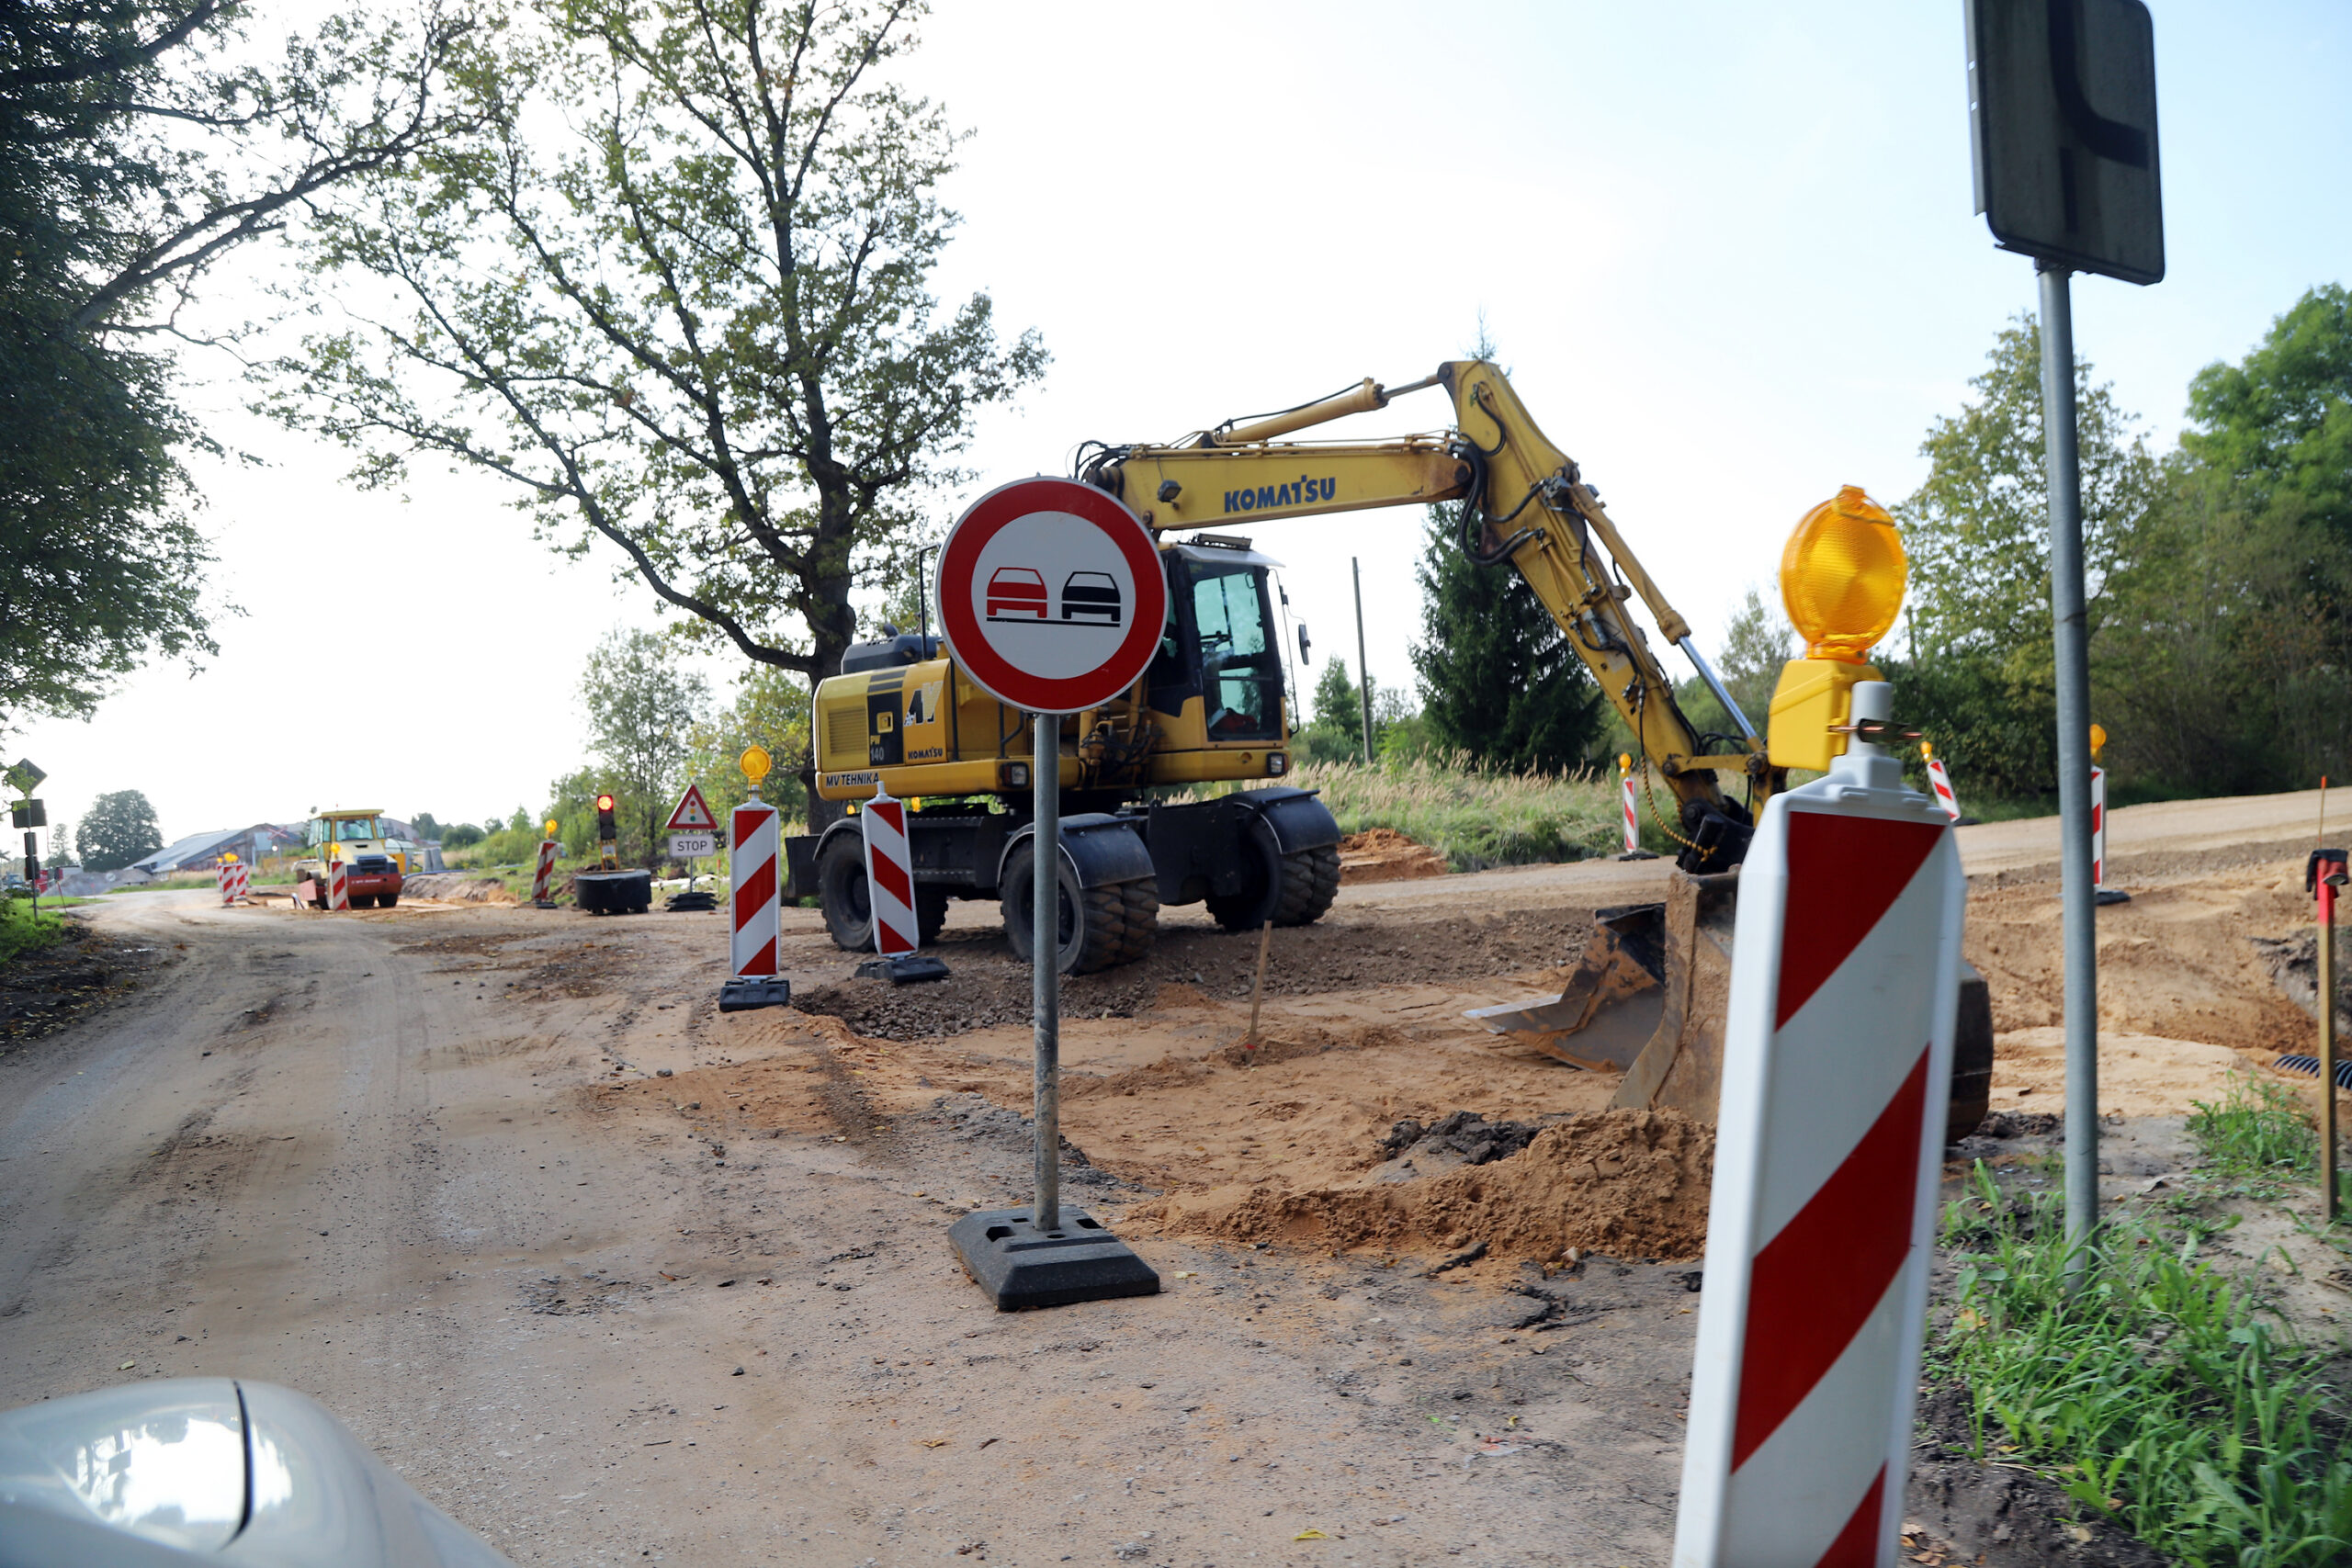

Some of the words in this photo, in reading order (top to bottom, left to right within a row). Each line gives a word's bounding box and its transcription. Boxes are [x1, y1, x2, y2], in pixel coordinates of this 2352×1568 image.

[1224, 475, 1336, 513] KOMATSU
[870, 747, 885, 761] 140
[908, 747, 944, 760] KOMATSU
[826, 774, 840, 787] MV
[842, 773, 879, 785] TEHNIKA
[677, 840, 707, 852] STOP
